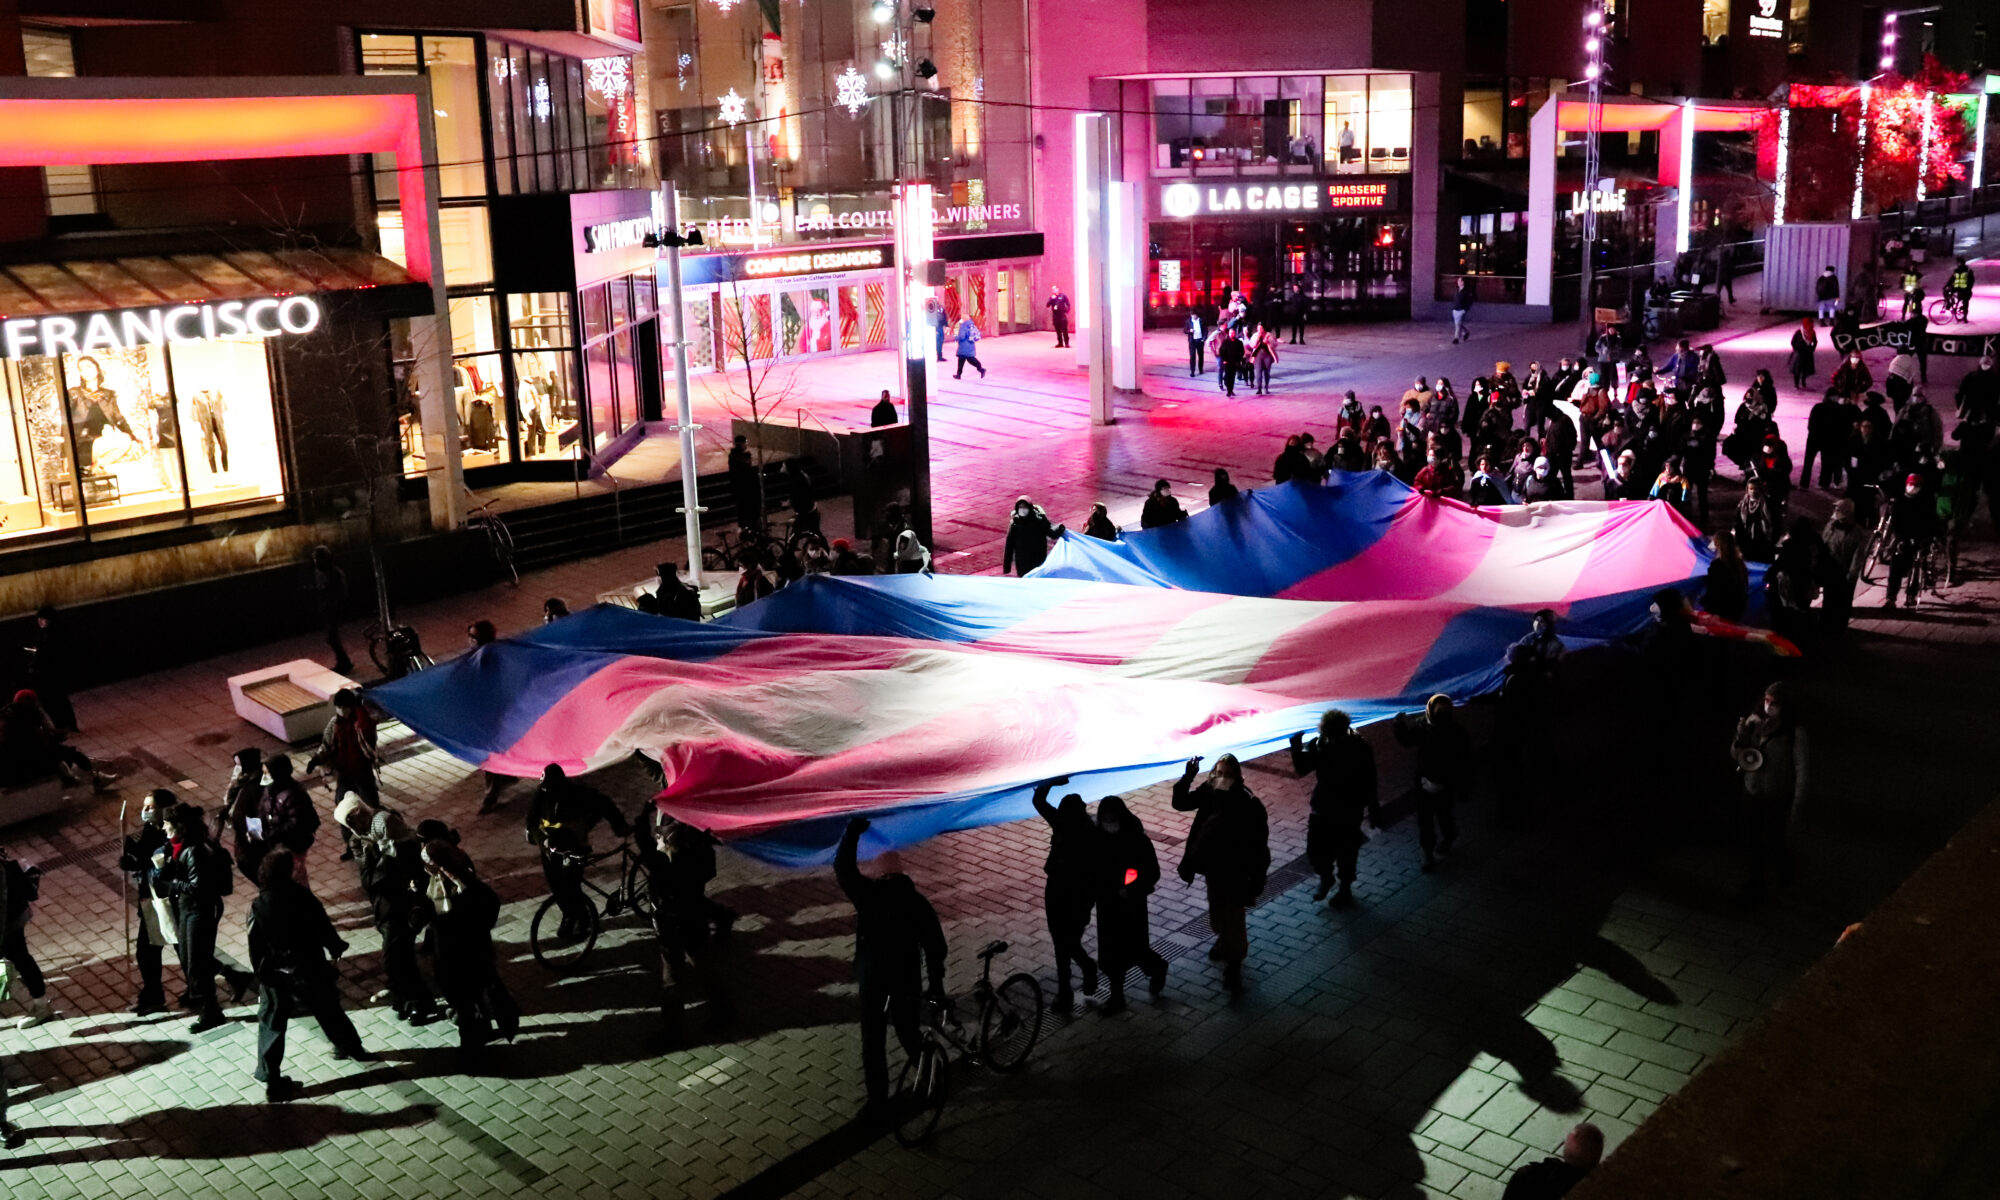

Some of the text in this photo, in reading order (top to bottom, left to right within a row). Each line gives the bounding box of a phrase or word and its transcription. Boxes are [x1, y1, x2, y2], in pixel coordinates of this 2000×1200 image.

[1209, 185, 1318, 210] LA CAGE
[1328, 184, 1387, 196] BRASSERIE
[1332, 196, 1383, 207] SPORTIVE
[1573, 188, 1626, 215] LA CAGE
[947, 203, 1021, 223] WINNERS
[592, 224, 612, 253] SAN
[745, 250, 882, 275] COMPLEXE DESJARDINS
[3, 296, 320, 361] FRANCISCO
